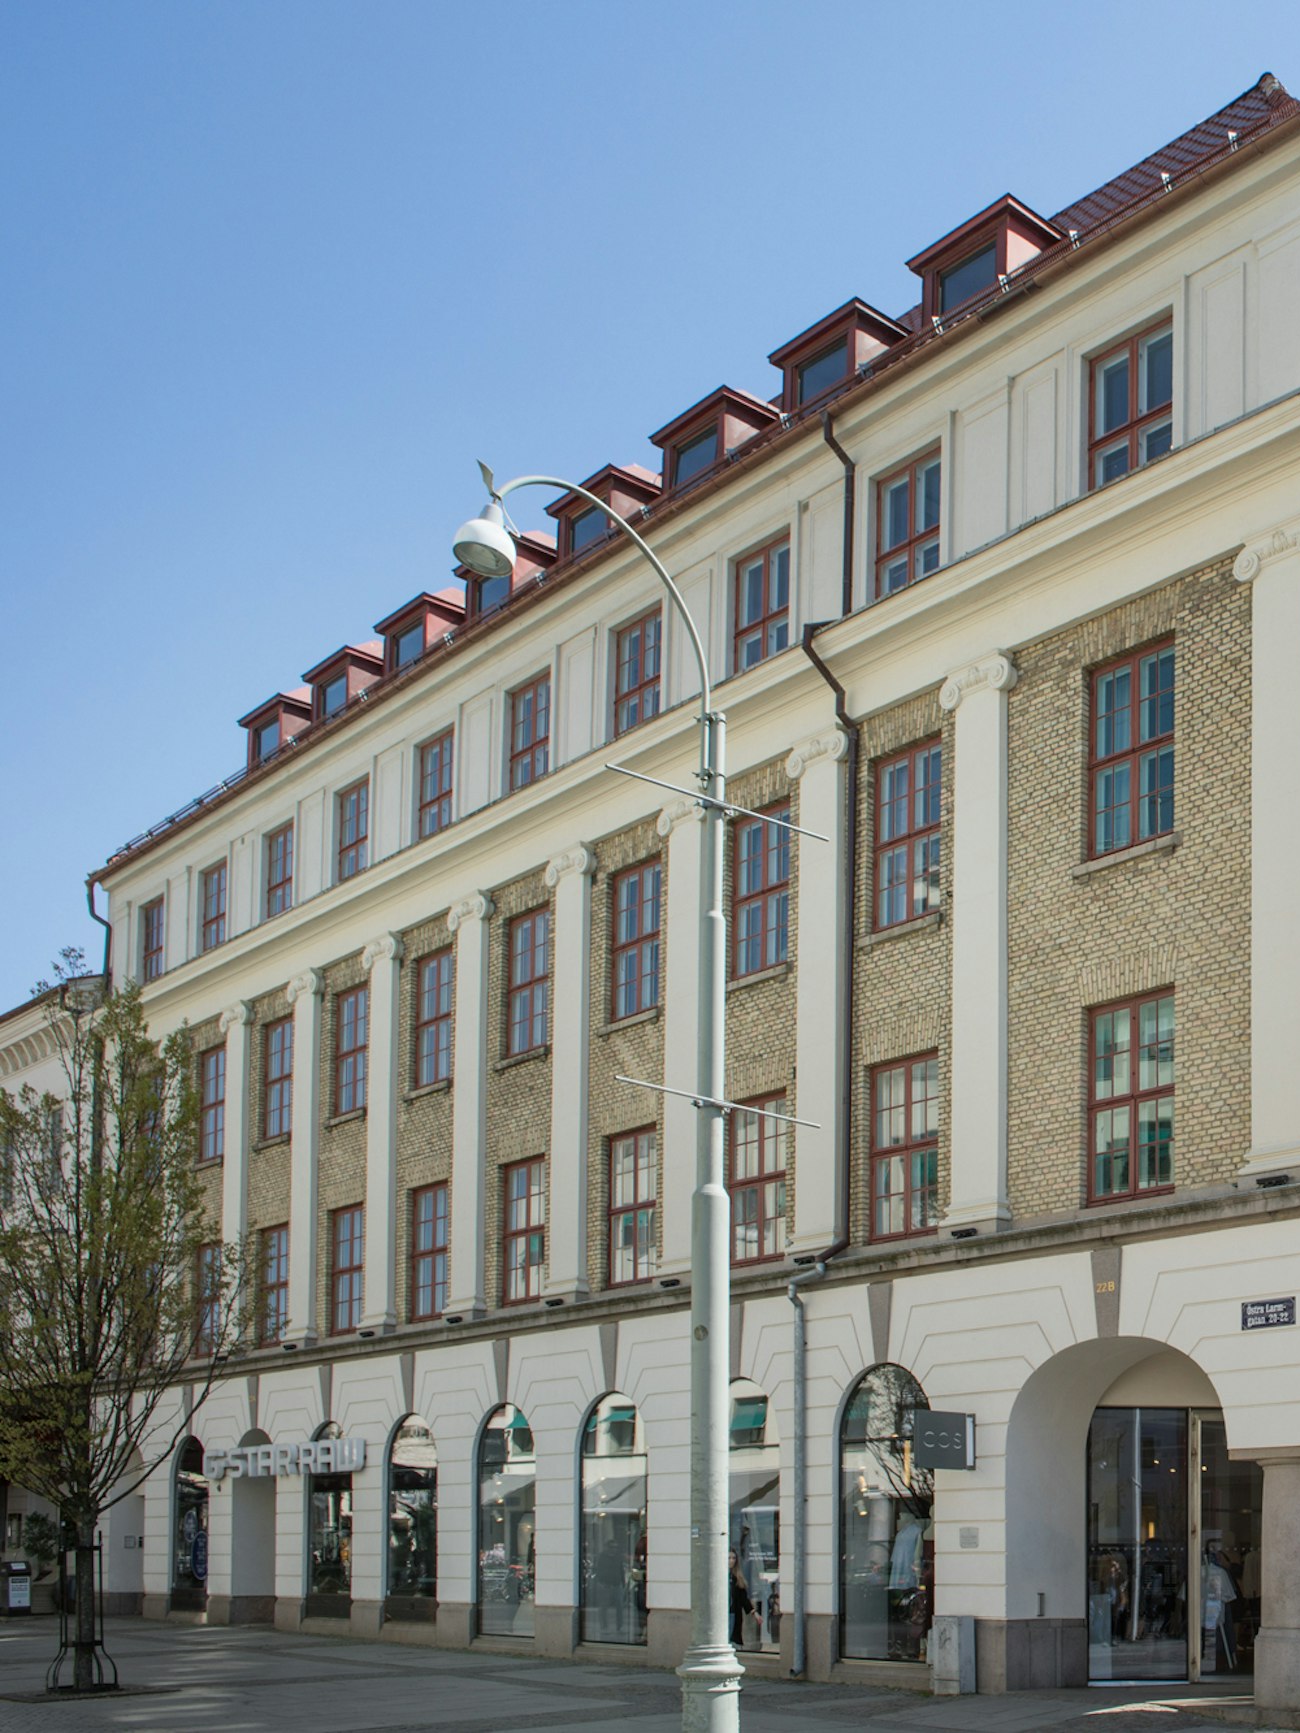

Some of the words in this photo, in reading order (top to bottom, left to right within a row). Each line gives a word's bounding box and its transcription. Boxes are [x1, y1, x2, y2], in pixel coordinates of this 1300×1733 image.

[1247, 1303, 1264, 1315] Östra
[1265, 1302, 1286, 1313] Larm-
[1247, 1315, 1266, 1327] gatan
[1269, 1312, 1289, 1324] 20-22
[923, 1430, 963, 1450] COS
